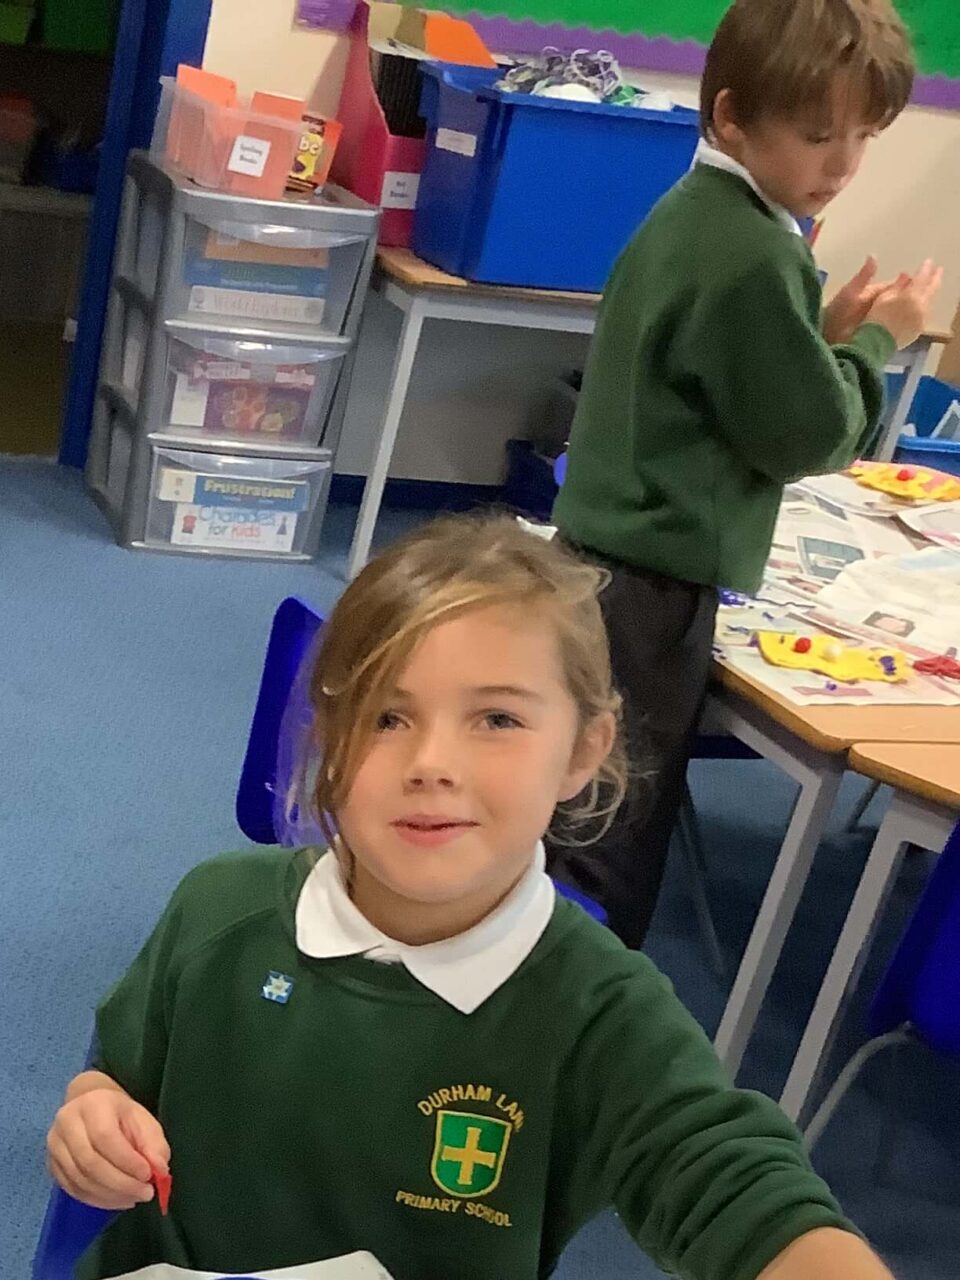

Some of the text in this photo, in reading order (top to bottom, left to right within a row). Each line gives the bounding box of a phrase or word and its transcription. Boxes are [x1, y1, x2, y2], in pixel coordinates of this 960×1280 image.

[417, 1084, 526, 1132] DURHAM LAN
[395, 1190, 512, 1227] PRIMARY SCHOOL
